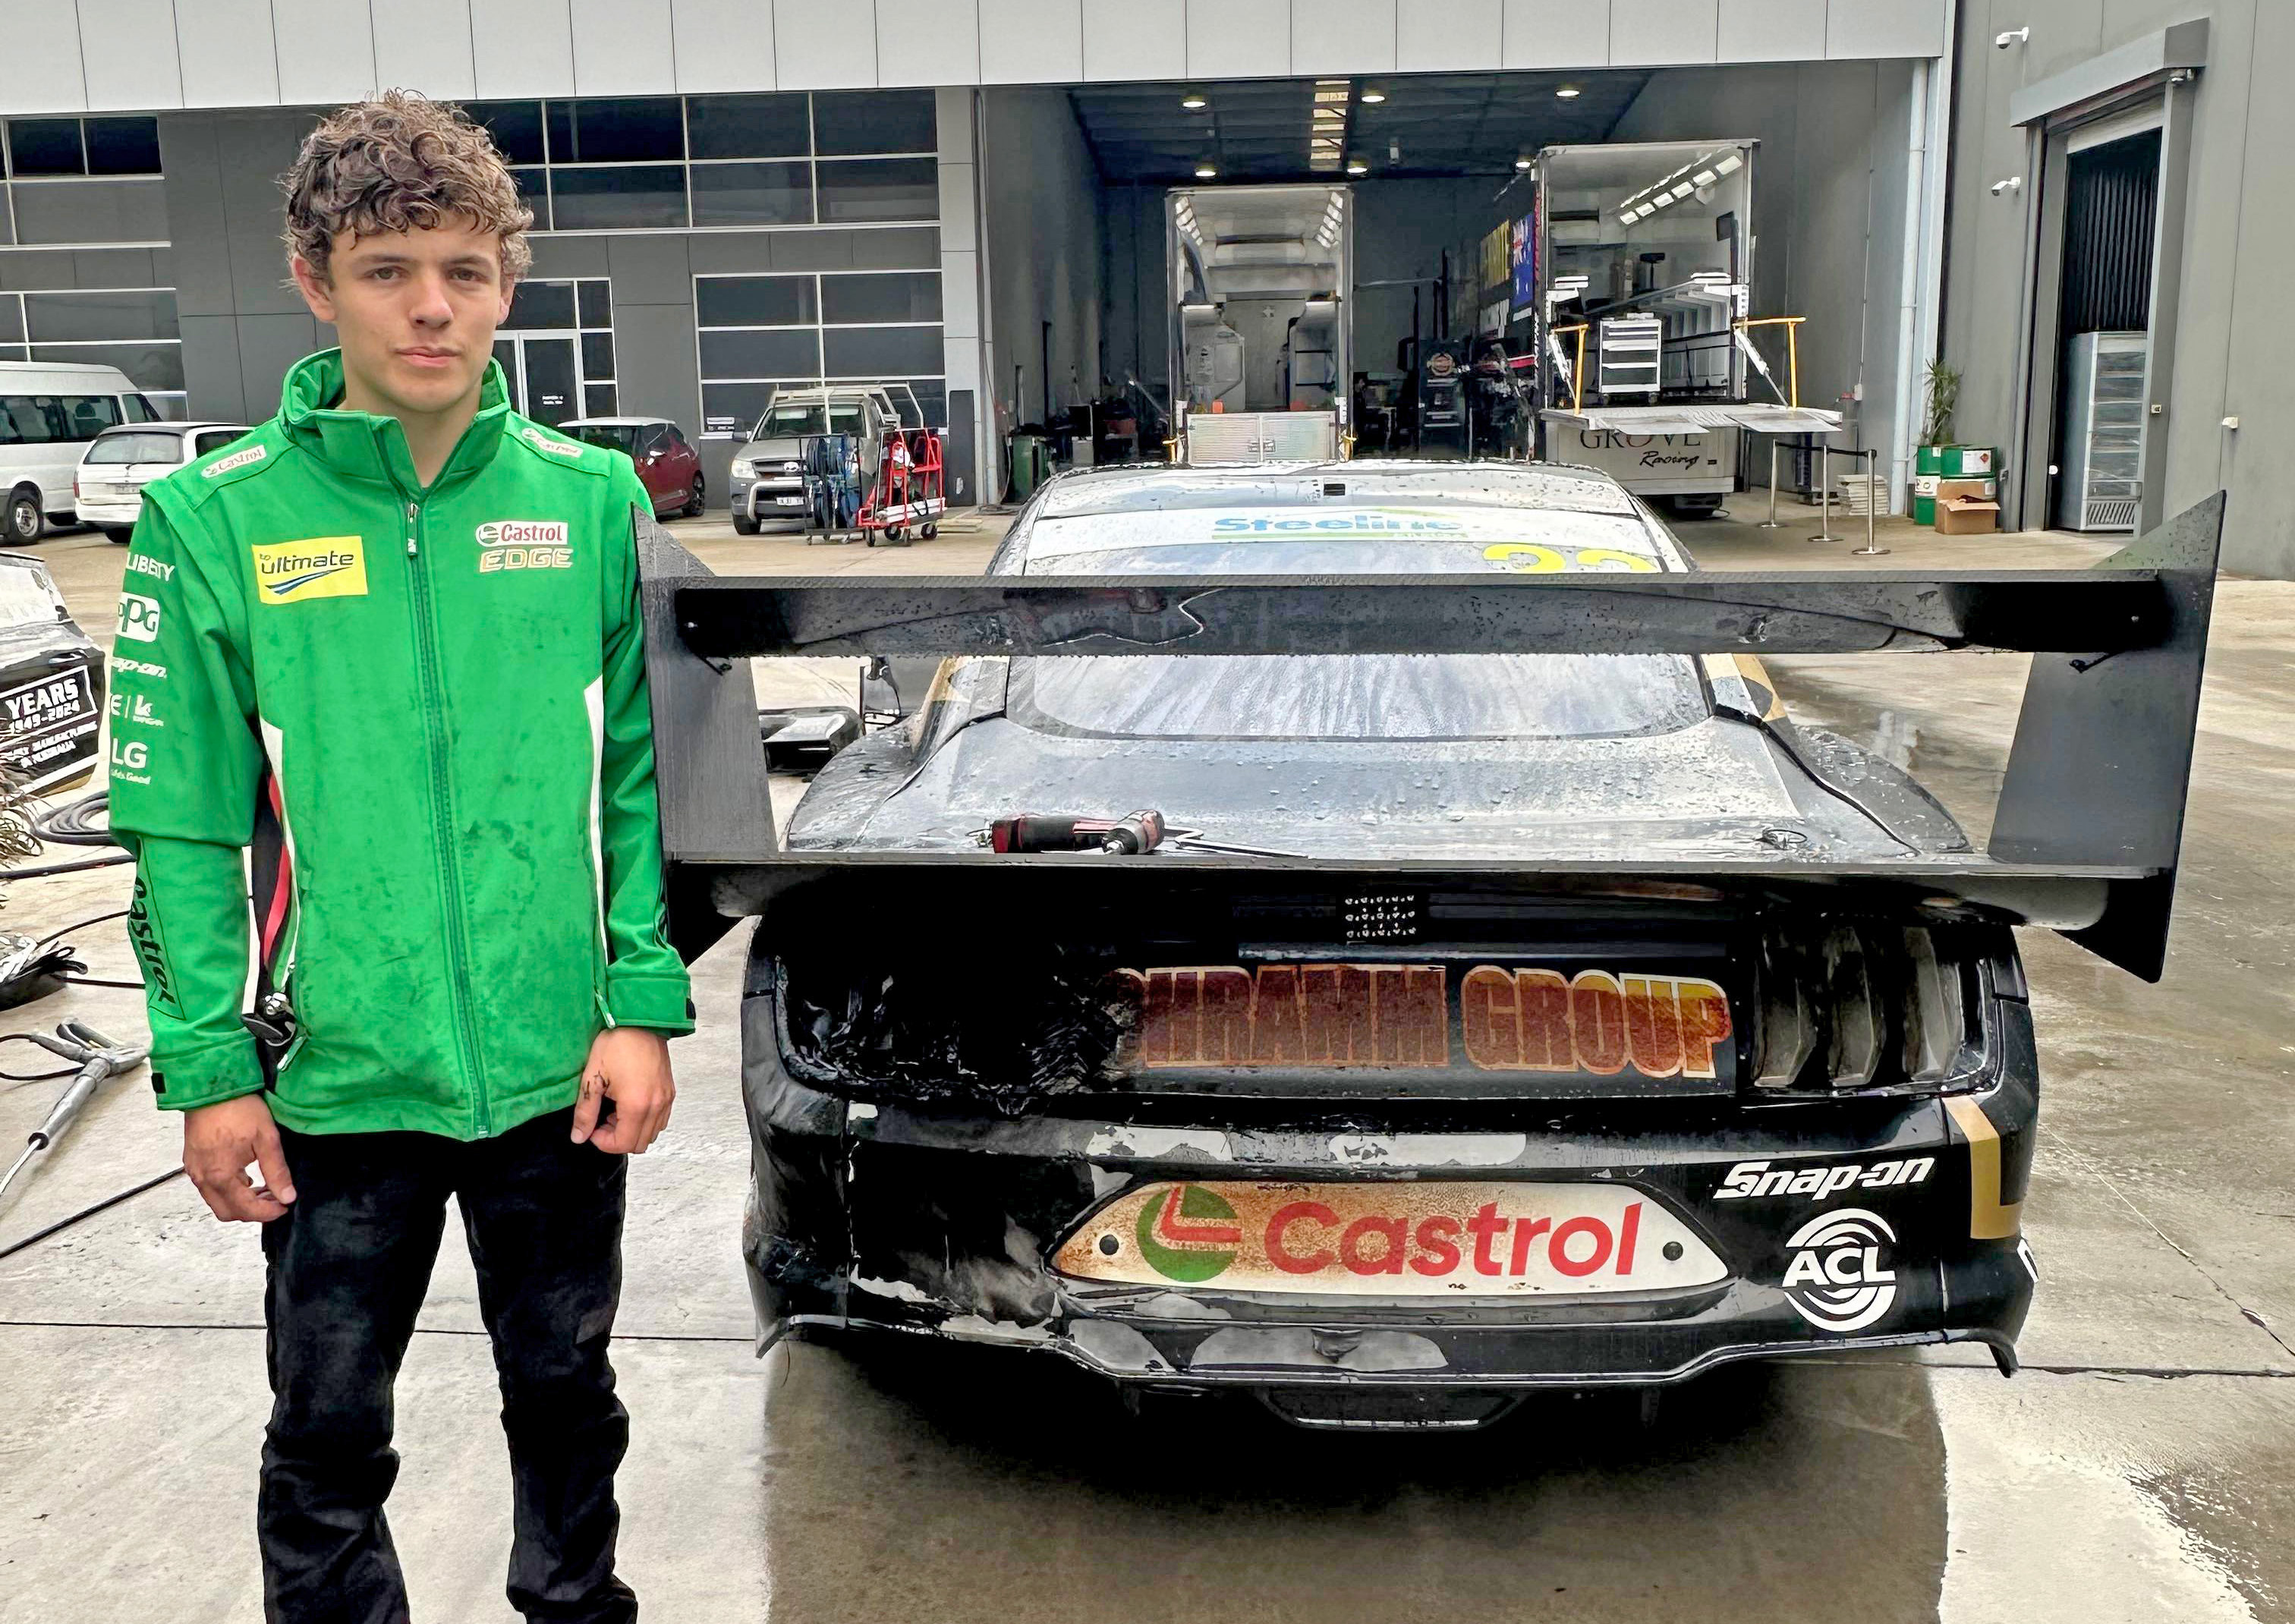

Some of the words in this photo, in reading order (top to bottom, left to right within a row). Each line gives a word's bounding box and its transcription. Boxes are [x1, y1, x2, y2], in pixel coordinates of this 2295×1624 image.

[1639, 450, 1700, 471] Racing
[501, 524, 562, 542] Castrol
[261, 550, 354, 574] ultimate
[479, 547, 575, 573] EDGE
[5, 678, 79, 720] YEARS
[112, 738, 148, 769] LG
[1460, 964, 1733, 1079] GROUP
[1713, 1157, 1935, 1201] Snap-on
[1264, 1201, 1643, 1277] Castrol
[1782, 1246, 1896, 1287] ACL
